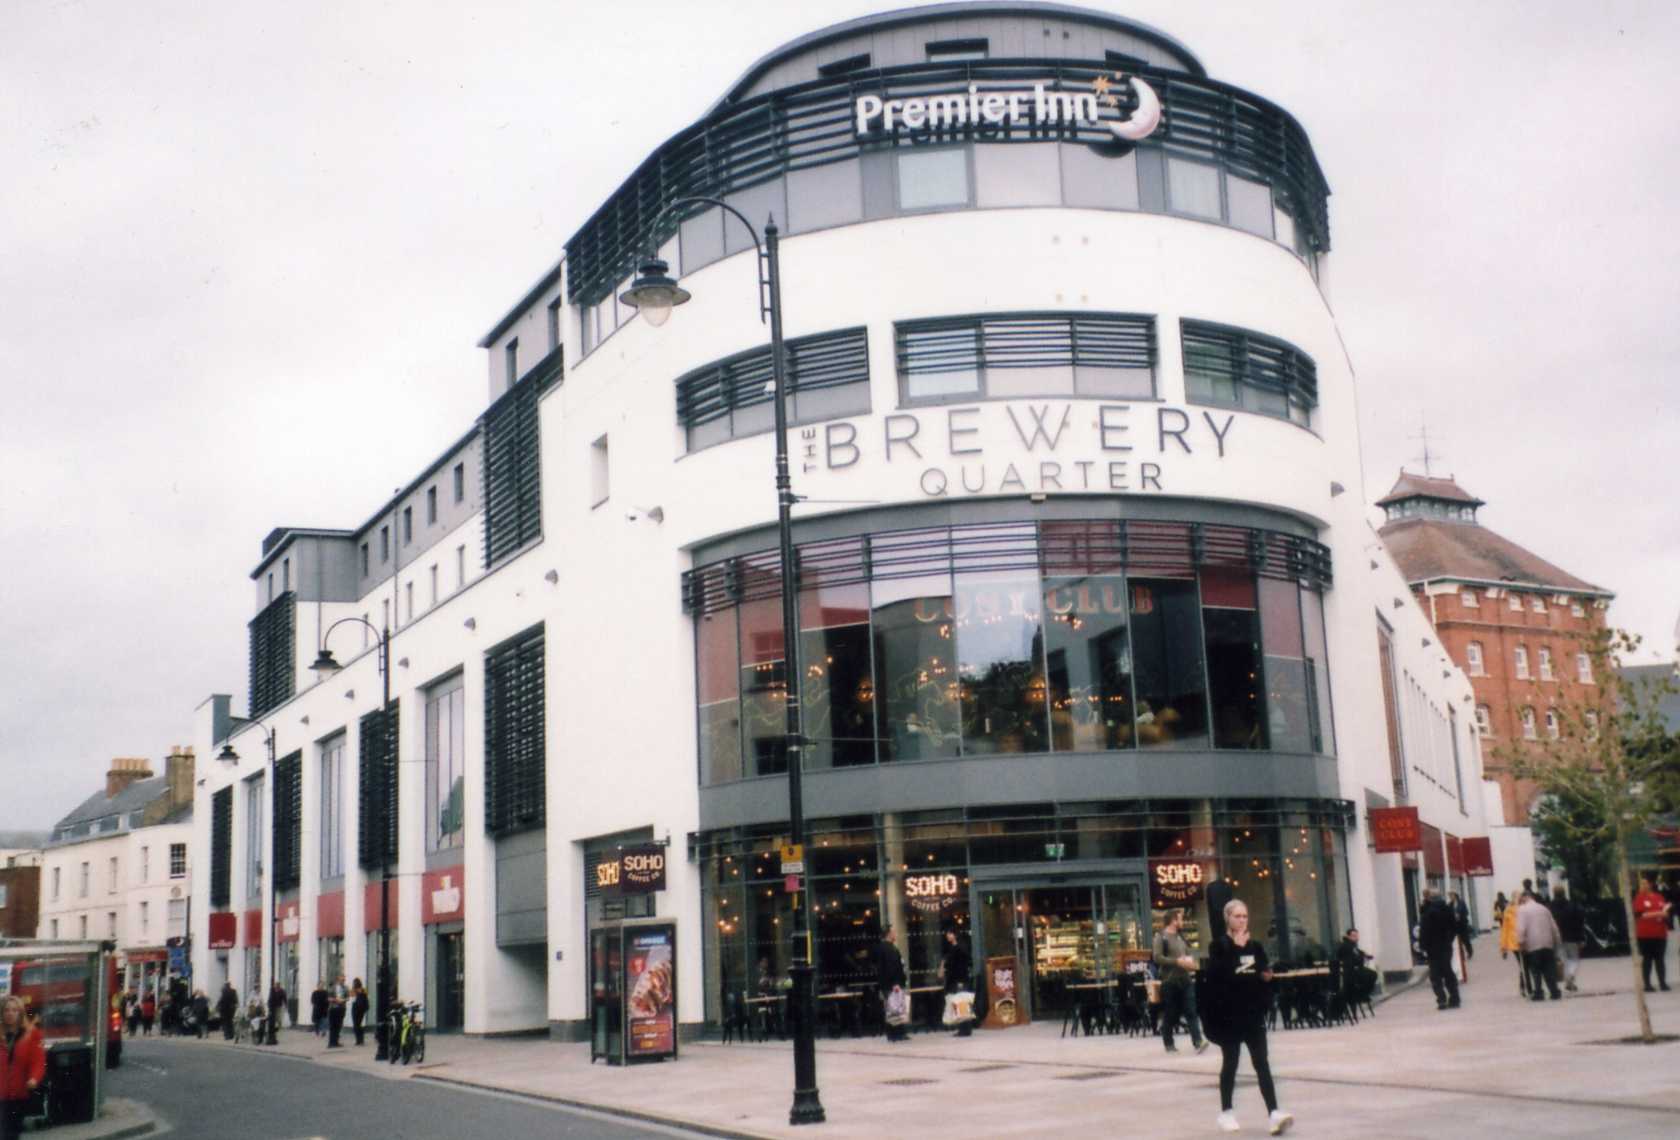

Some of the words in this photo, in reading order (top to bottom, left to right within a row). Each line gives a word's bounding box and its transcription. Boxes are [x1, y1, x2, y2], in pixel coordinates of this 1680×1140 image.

[855, 84, 1021, 134] Premier
[1035, 83, 1099, 122] Inn
[803, 428, 817, 473] THE
[824, 403, 1234, 471] BREWERY
[920, 461, 1163, 496] QUARTER
[1046, 584, 1153, 615] CLUB
[597, 861, 620, 886] SOHO
[623, 854, 664, 872] SOHO
[1156, 863, 1202, 885] SOHO
[905, 874, 958, 897] SOHO
[911, 898, 941, 912] COFFEE
